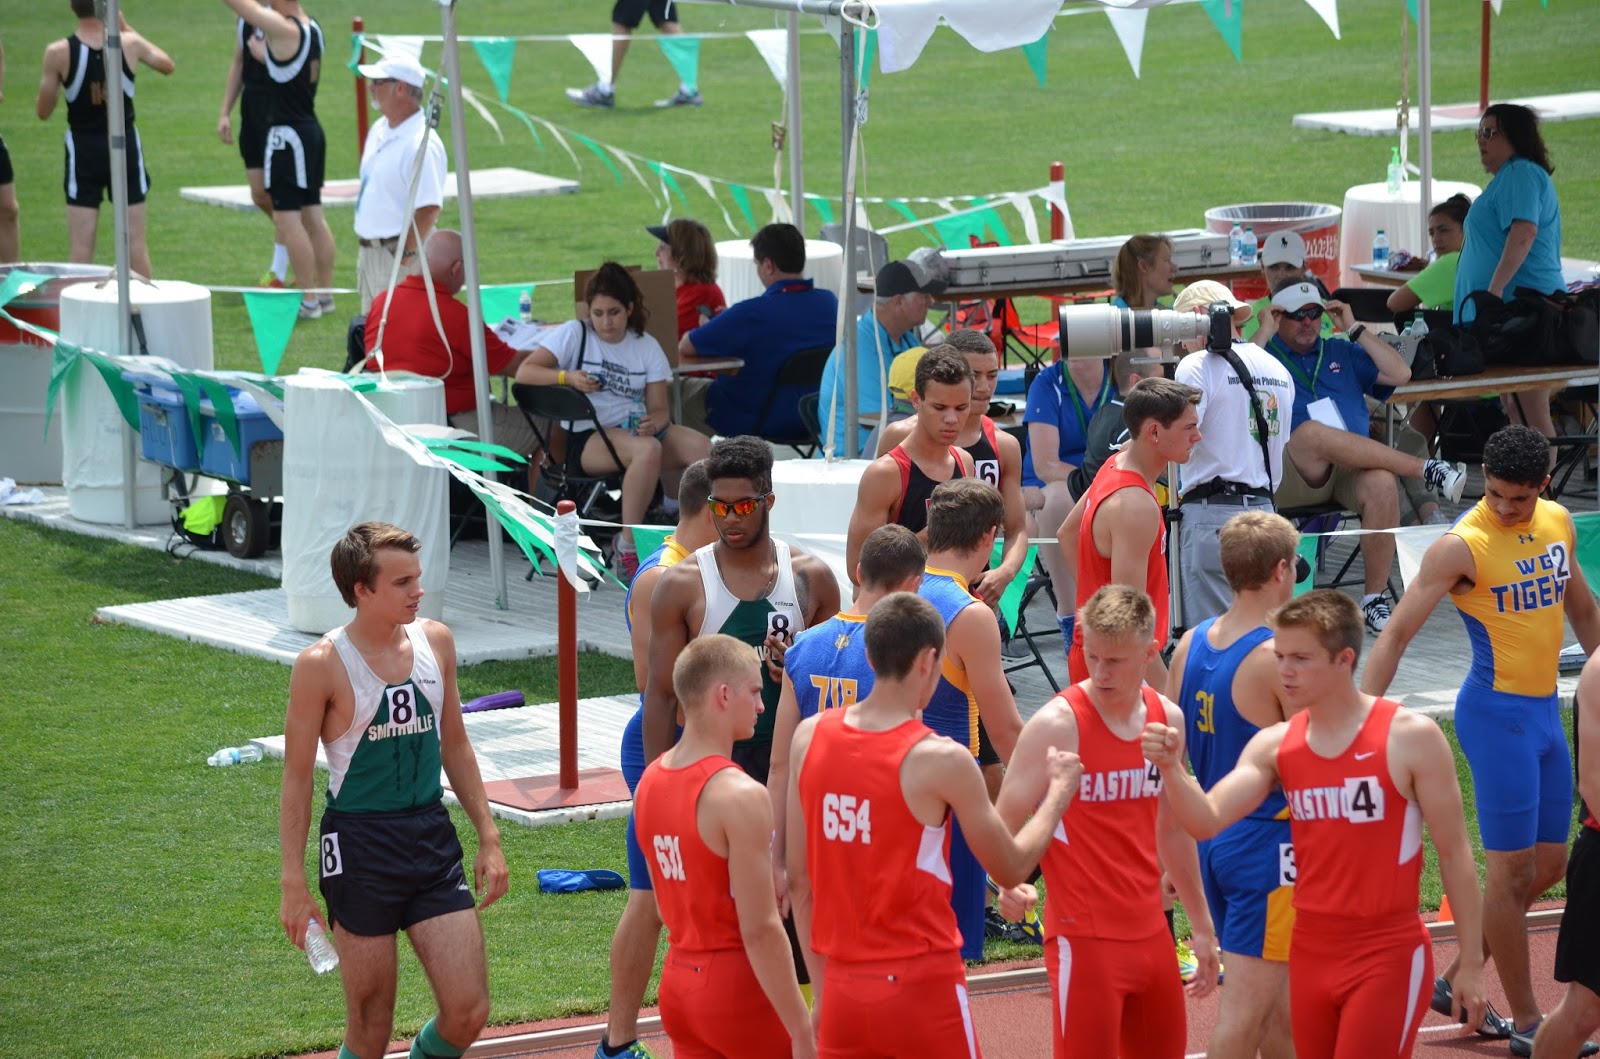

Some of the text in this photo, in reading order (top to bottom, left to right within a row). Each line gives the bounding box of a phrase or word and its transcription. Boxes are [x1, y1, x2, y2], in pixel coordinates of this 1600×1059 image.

[272, 129, 283, 148] 5
[980, 462, 996, 486] 6
[1551, 544, 1569, 579] 2
[770, 613, 790, 642] 8
[391, 688, 413, 725] 8
[808, 673, 858, 713] 718
[367, 713, 434, 742] SMITHVILLE
[1195, 690, 1215, 734] 31
[1147, 763, 1161, 789] 4
[1352, 780, 1377, 818] 4
[823, 792, 871, 844] 654
[323, 837, 338, 874] 8
[653, 834, 687, 881] 631
[1283, 846, 1297, 883] 3
